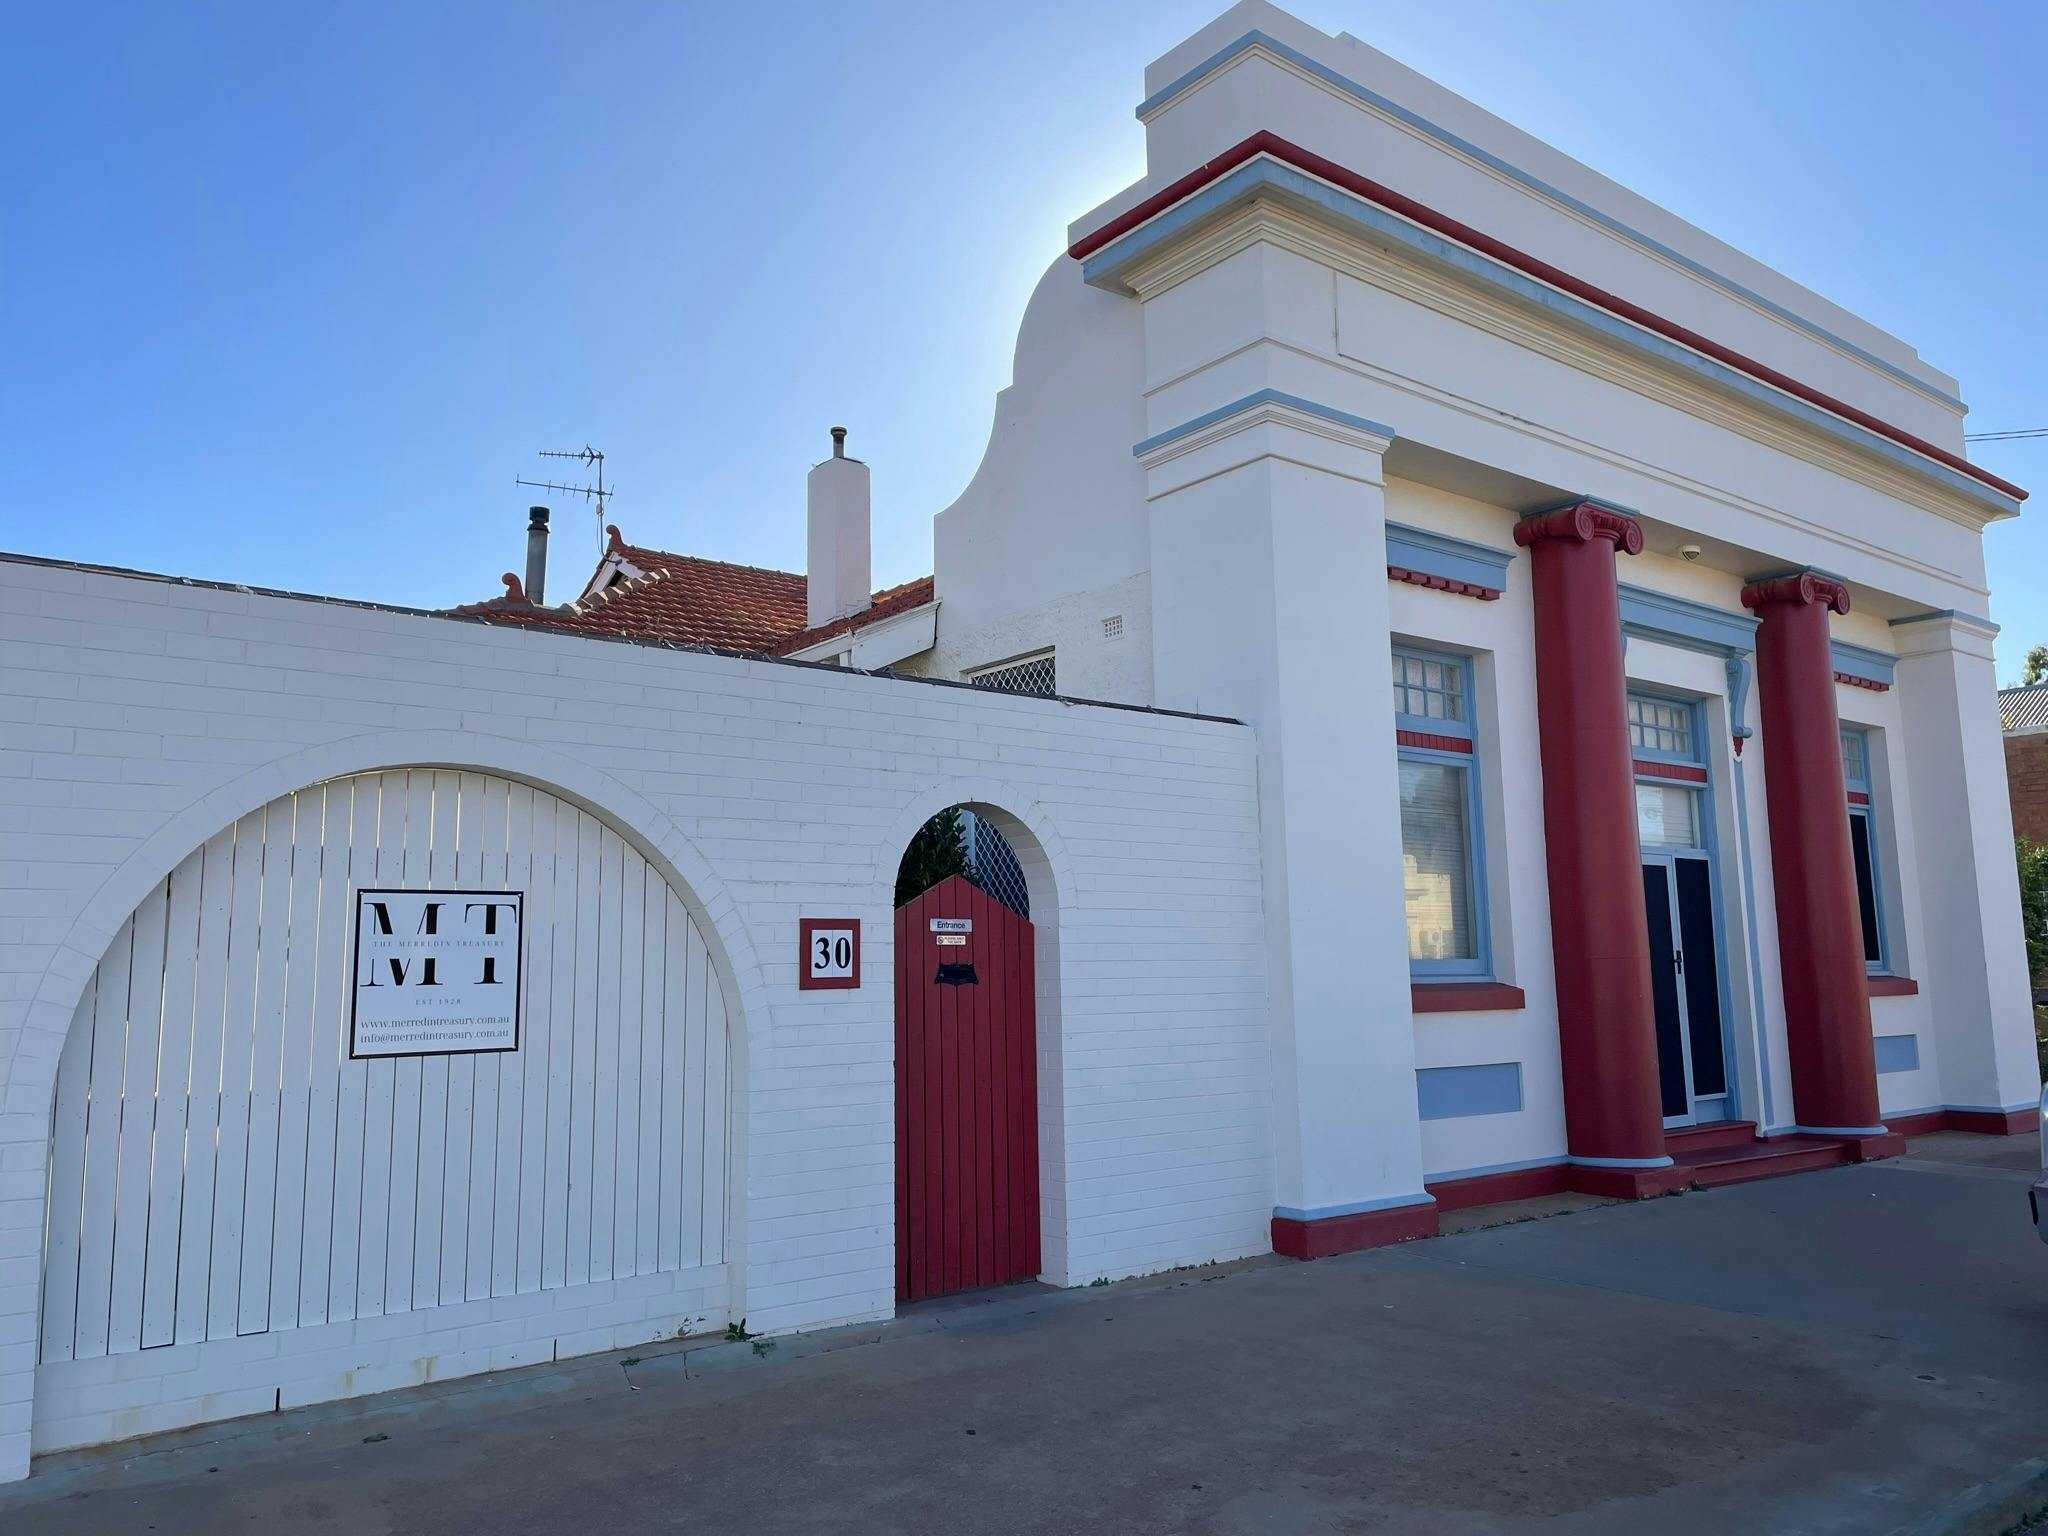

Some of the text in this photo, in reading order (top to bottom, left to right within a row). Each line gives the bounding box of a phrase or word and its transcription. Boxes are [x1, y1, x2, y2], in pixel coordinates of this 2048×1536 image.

[937, 920, 966, 929] Entrance
[814, 936, 851, 969] 30
[360, 1015, 510, 1029] www.merredintreasury.com.au
[360, 1029, 509, 1044] info@merredintreasury.com.au
